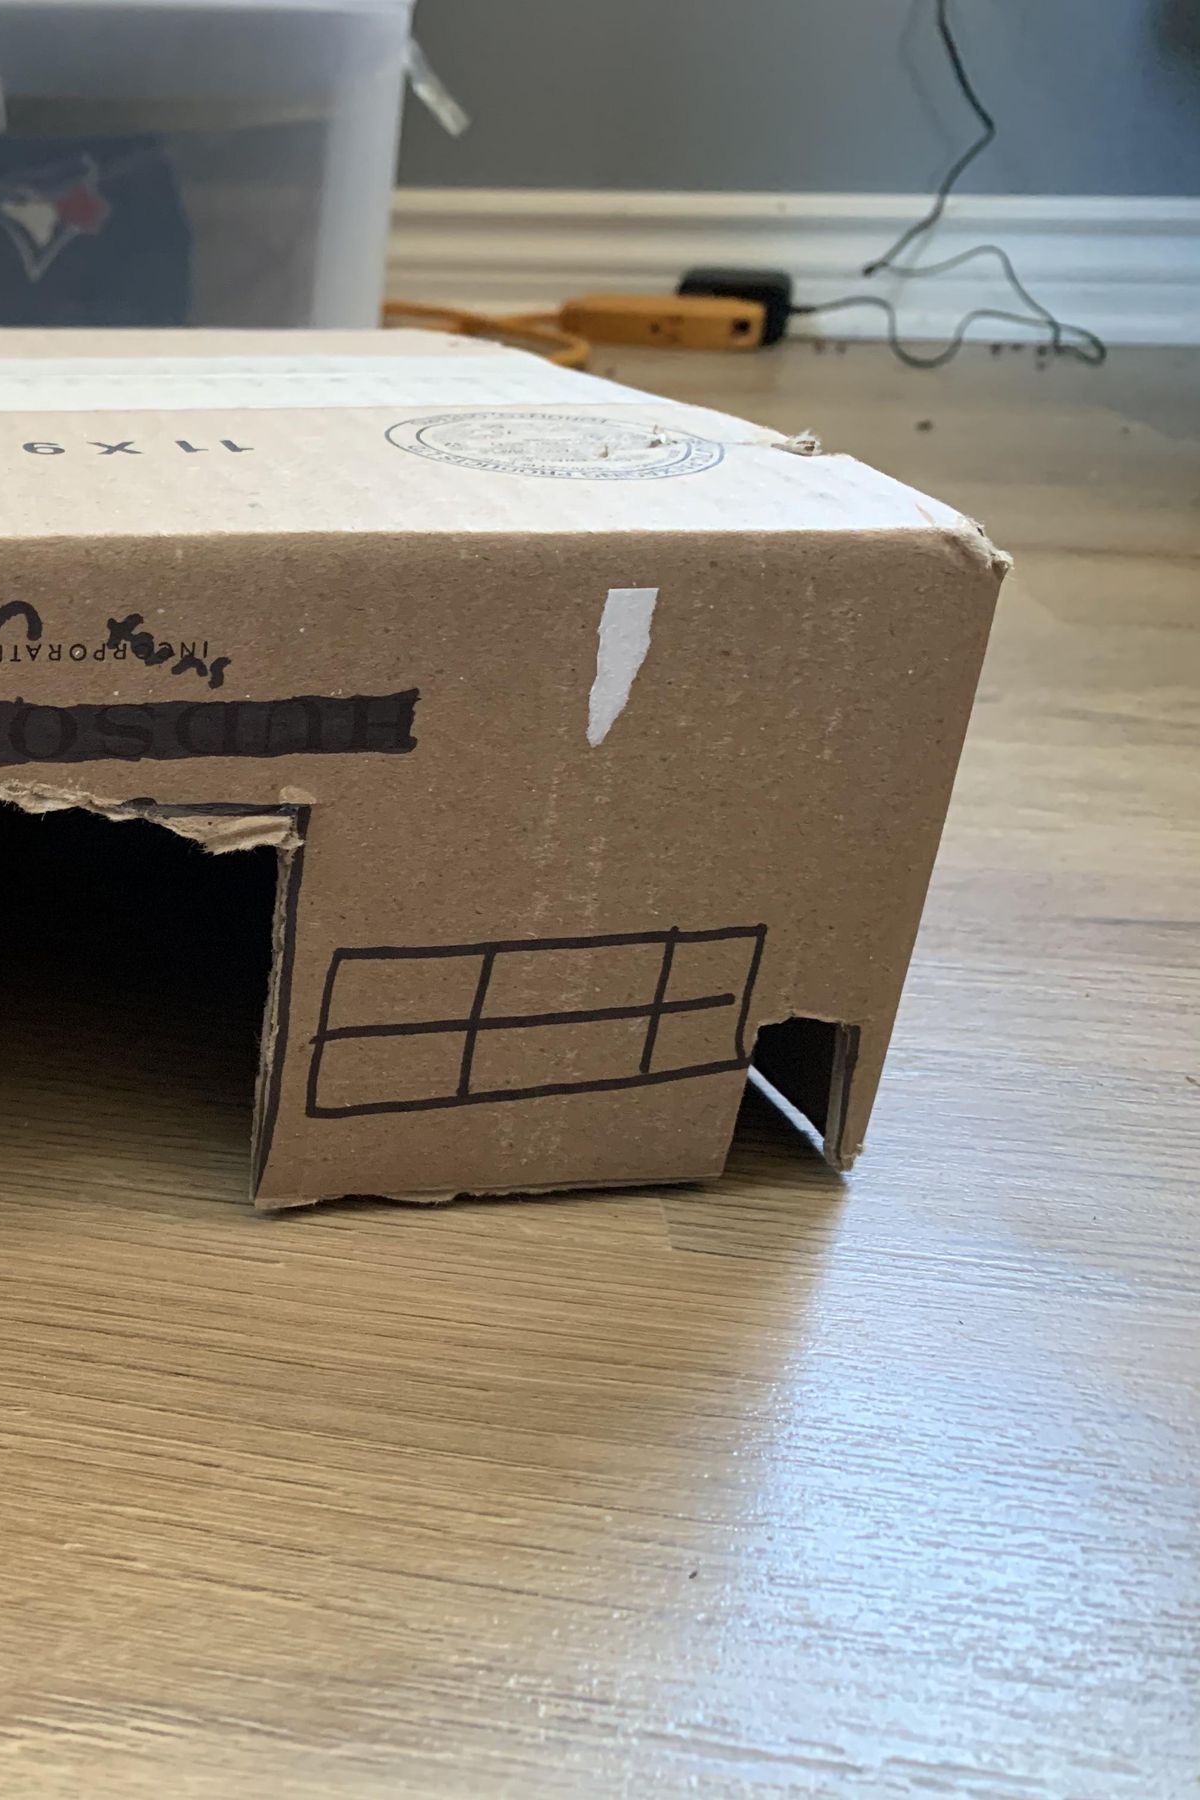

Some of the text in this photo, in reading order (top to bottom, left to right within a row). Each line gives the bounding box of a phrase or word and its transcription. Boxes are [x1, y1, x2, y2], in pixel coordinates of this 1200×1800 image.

[22, 442, 66, 455] 9
[86, 440, 144, 455] X
[174, 439, 255, 453] 11
